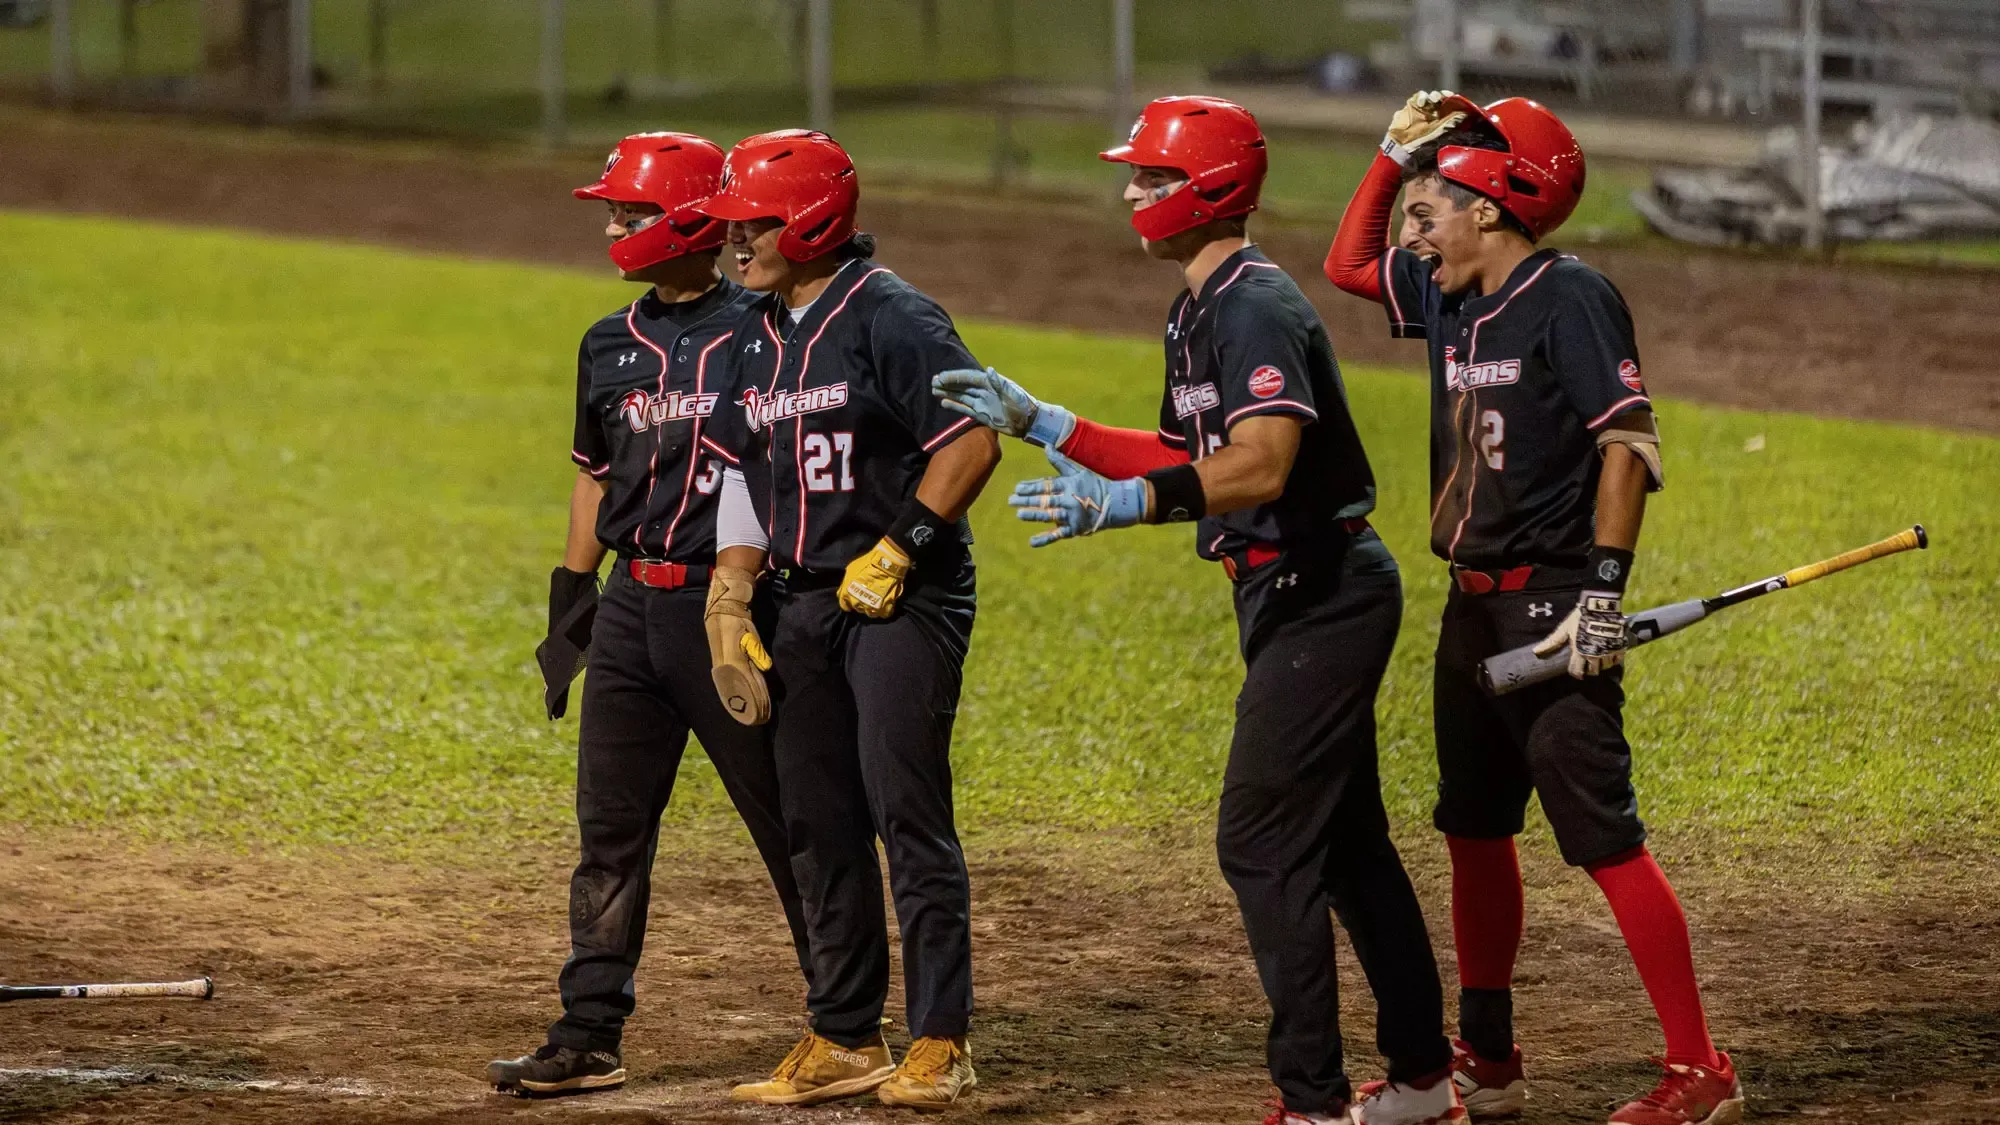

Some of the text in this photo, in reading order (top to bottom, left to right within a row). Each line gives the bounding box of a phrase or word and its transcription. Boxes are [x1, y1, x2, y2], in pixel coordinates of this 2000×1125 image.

[794, 196, 829, 220] EVOSHIELD
[733, 381, 848, 433] Vulcans
[803, 431, 856, 493] 27
[1480, 408, 1505, 472] 2
[829, 1049, 869, 1066] ADIZERO
